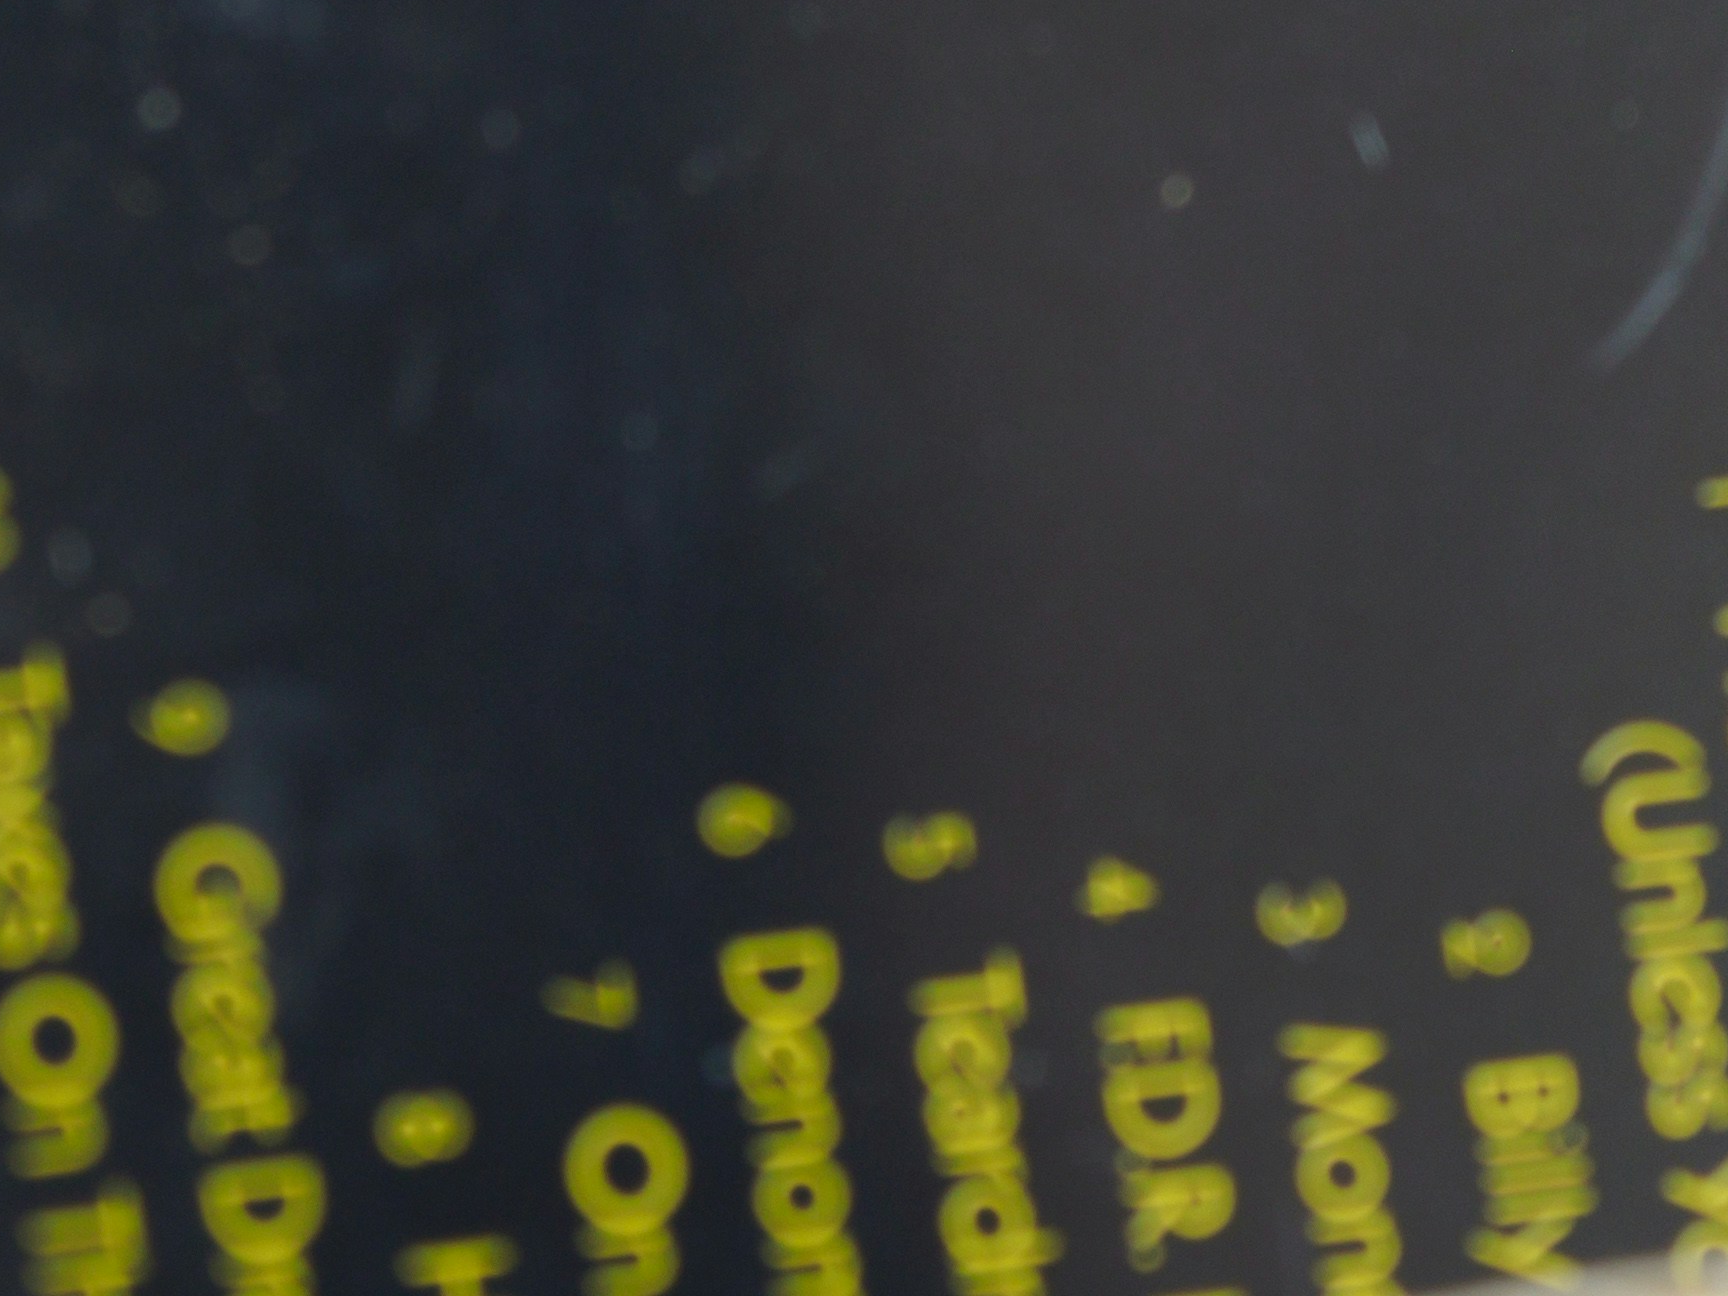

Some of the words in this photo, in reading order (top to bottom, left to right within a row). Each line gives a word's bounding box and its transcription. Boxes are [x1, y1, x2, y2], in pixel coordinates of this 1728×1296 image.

[129, 678, 231, 756] 9
[696, 782, 792, 857] 6
[883, 810, 977, 880] 5
[1082, 855, 1161, 922] 4
[1255, 876, 1347, 948] 3
[1441, 909, 1532, 978] 2
[154, 823, 301, 1155] Great
[540, 957, 638, 1030] 7
[375, 1087, 472, 1168] 8
[563, 1102, 690, 1296] On
[1463, 1054, 1598, 1291] Billy
